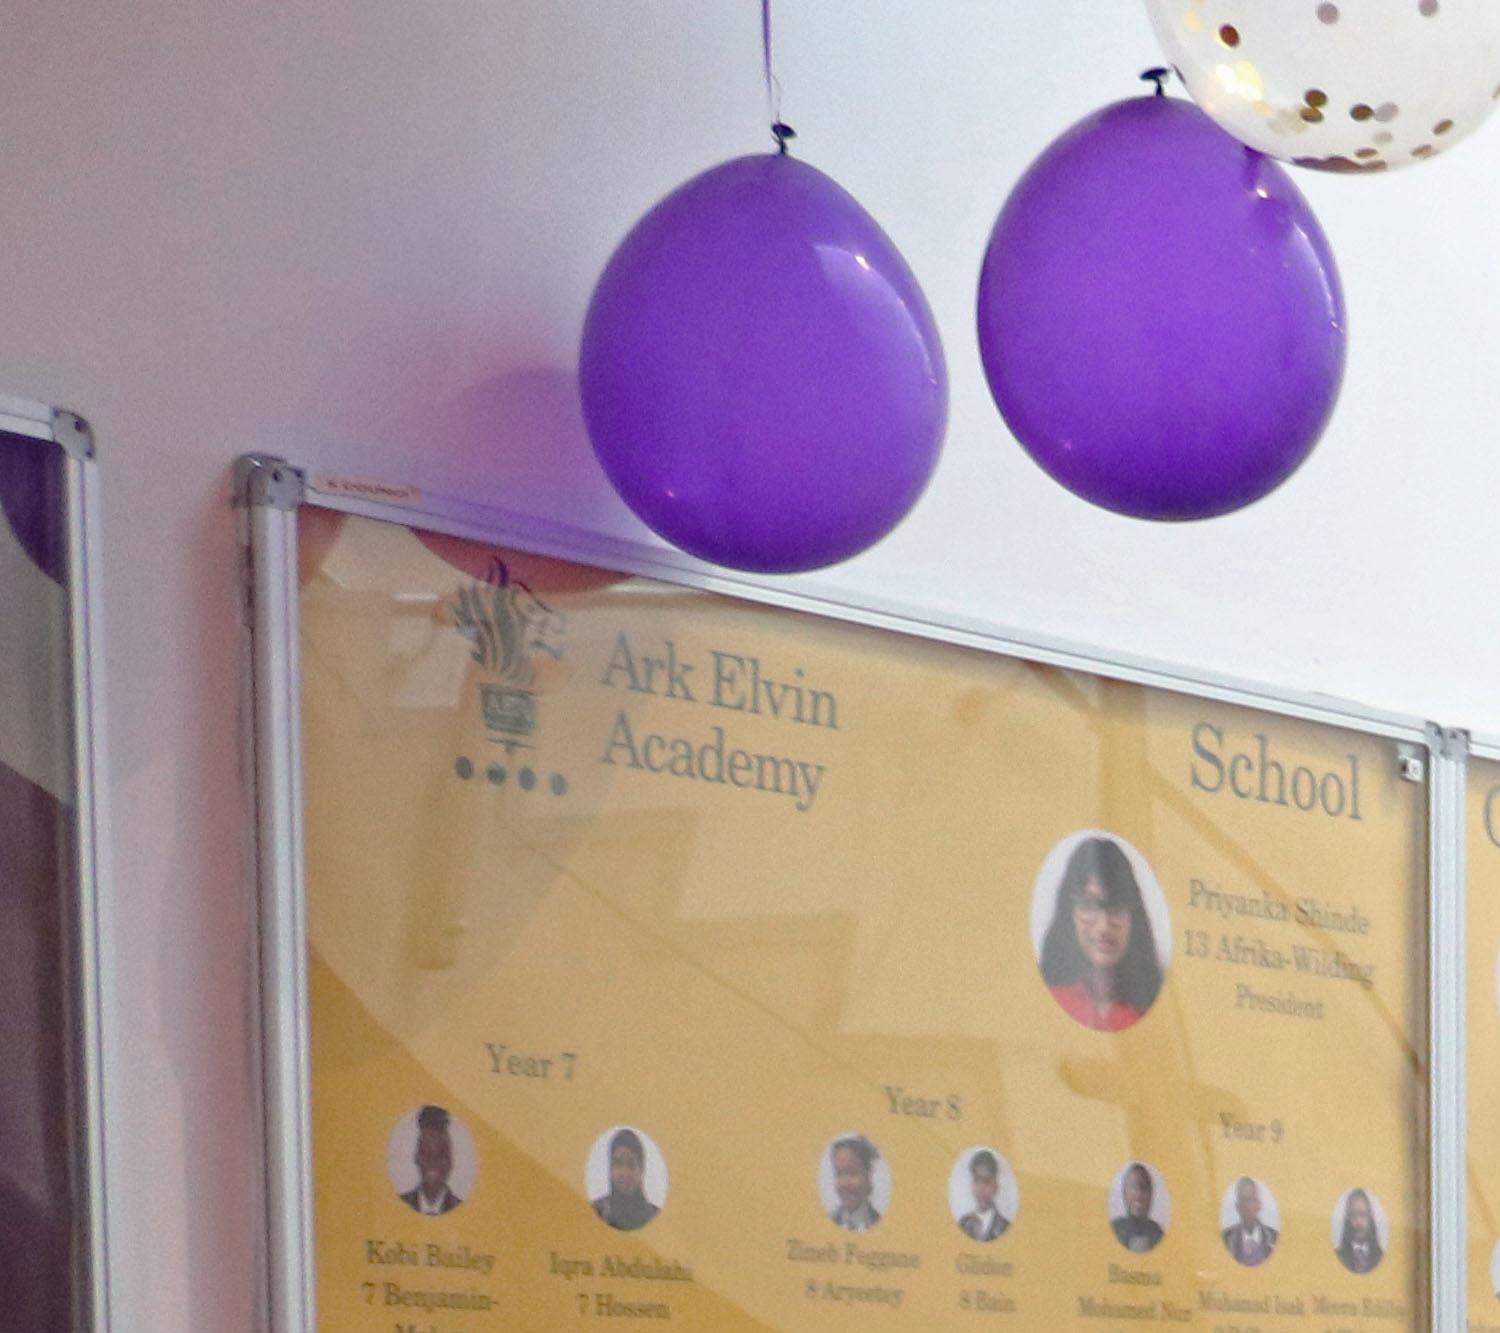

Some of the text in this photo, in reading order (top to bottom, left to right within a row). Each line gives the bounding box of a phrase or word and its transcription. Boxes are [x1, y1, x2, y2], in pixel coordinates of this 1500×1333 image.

[601, 631, 838, 730] Ark Elvin
[602, 711, 824, 812] Academy
[1190, 722, 1364, 821] School
[1188, 880, 1371, 936] Priyanka Shinde
[1184, 929, 1376, 990] 13 Afrika-Wilding
[1235, 983, 1326, 1021] President
[484, 1041, 576, 1080] Year 7
[885, 1086, 963, 1122] Year 8
[1220, 1112, 1285, 1145] Year 9
[366, 1241, 418, 1267] Kobi
[548, 1251, 594, 1281] Iqra
[361, 1282, 499, 1312] 7 Benjamin-
[576, 1294, 590, 1316] 7
